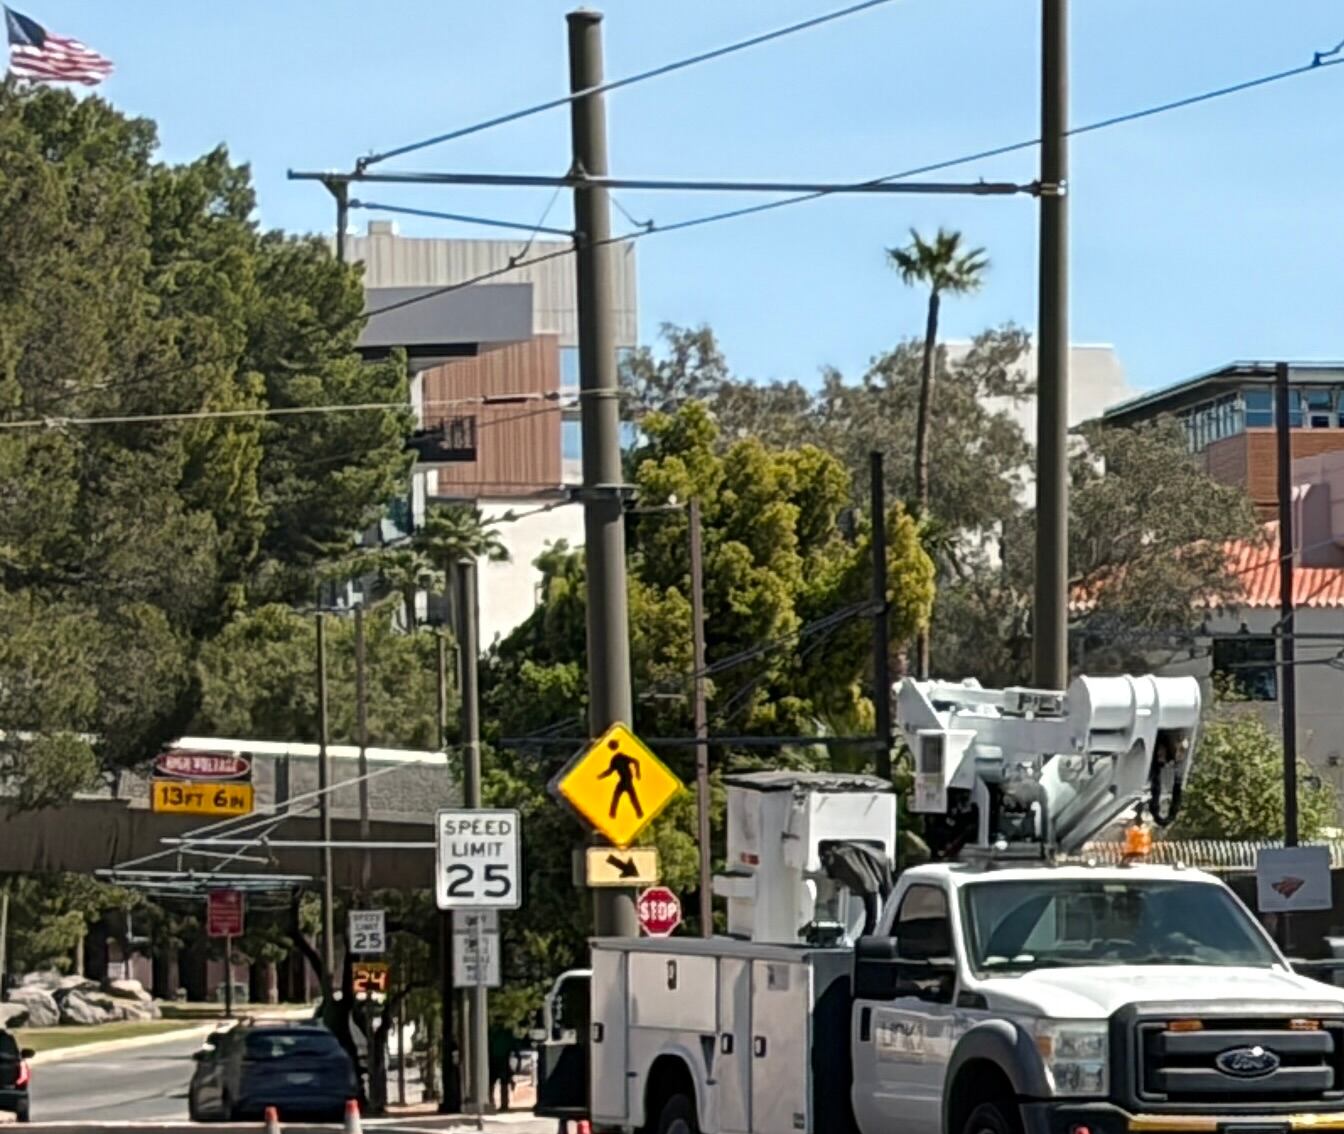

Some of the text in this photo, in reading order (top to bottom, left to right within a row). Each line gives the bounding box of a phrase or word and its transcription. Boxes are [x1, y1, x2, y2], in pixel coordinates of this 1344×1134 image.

[443, 818, 512, 837] SPEED
[451, 841, 504, 858] LIMIT
[445, 863, 512, 898] 25
[639, 900, 678, 922] STOP
[353, 932, 382, 950] 25
[352, 969, 387, 993] 24
